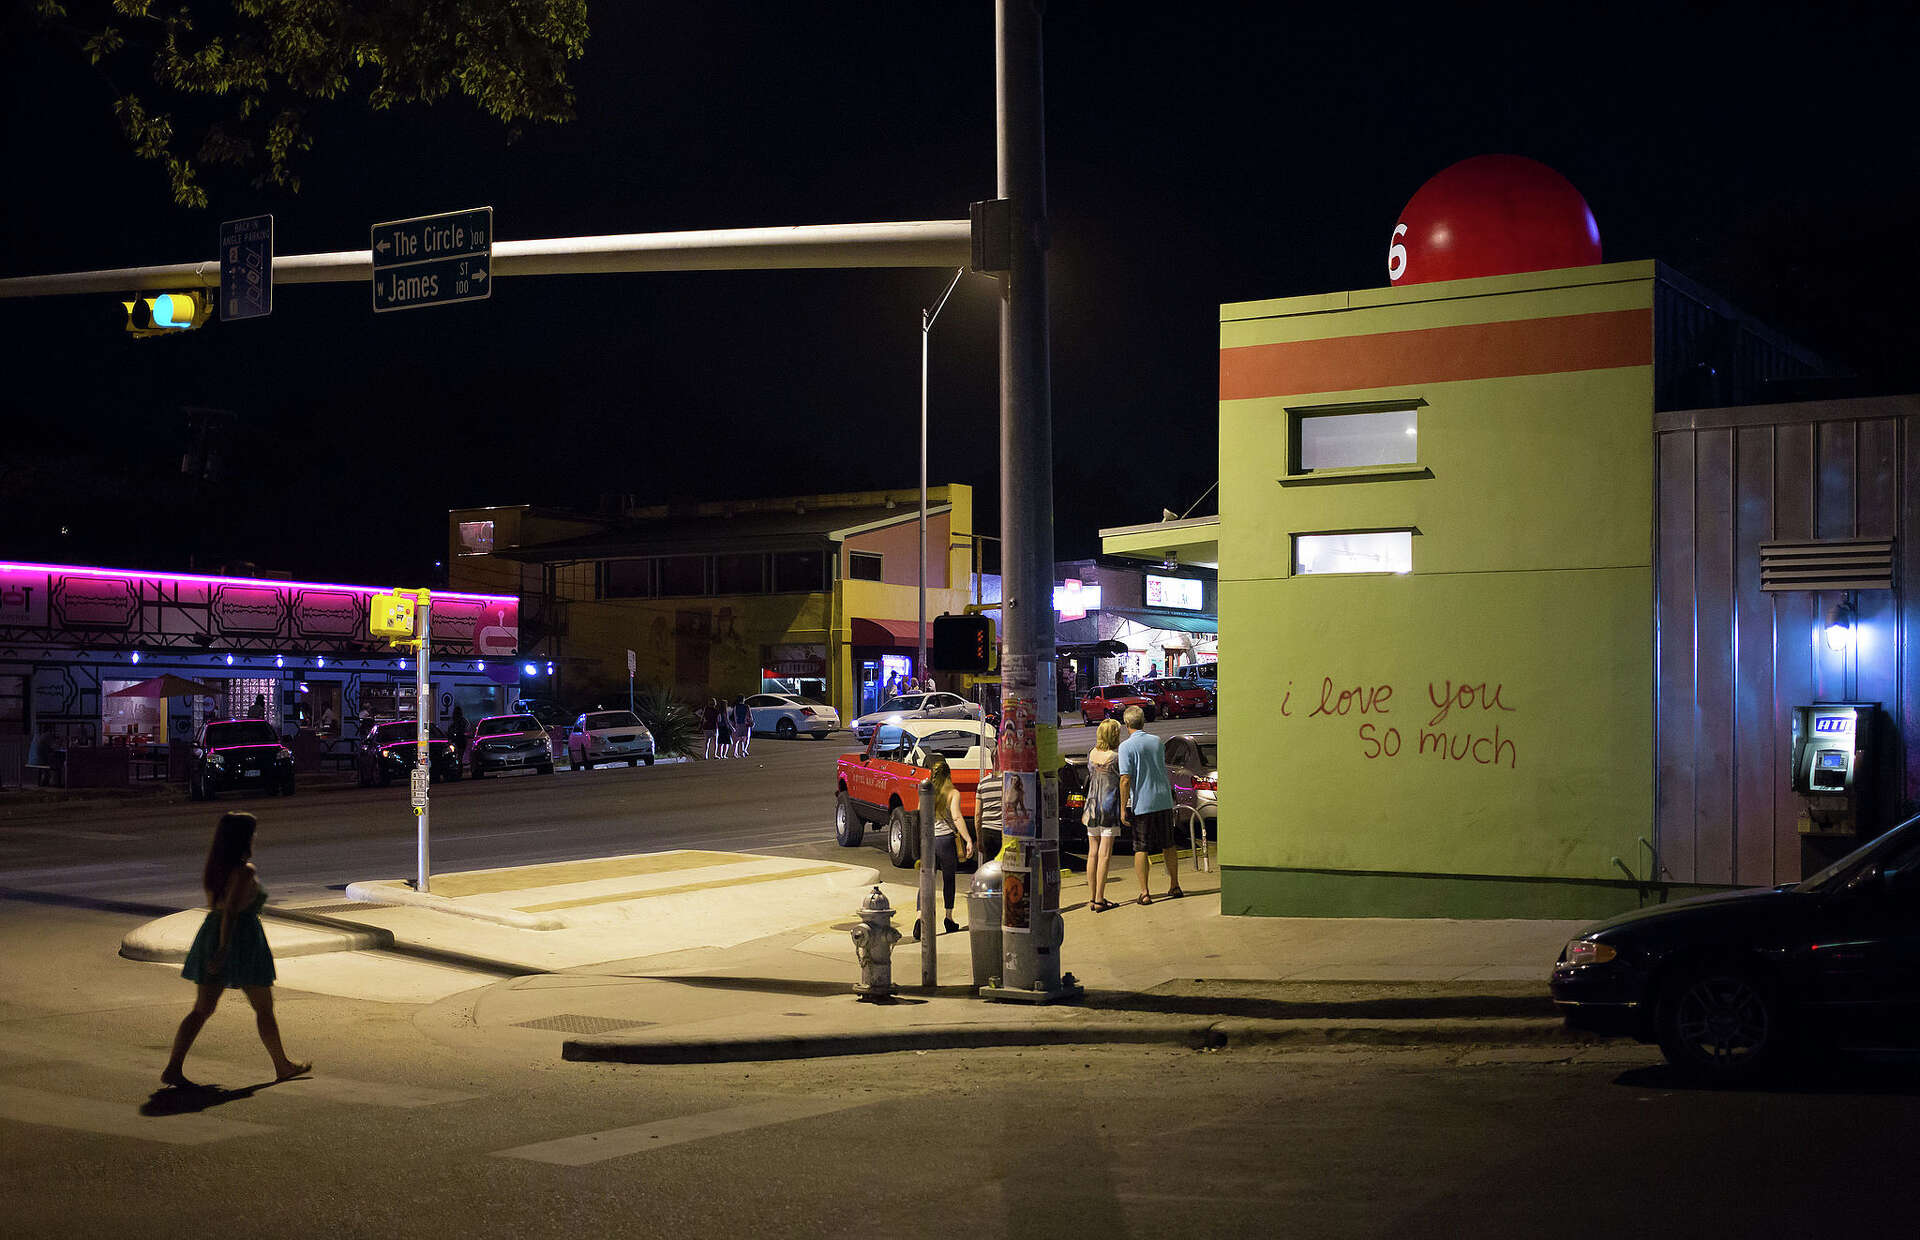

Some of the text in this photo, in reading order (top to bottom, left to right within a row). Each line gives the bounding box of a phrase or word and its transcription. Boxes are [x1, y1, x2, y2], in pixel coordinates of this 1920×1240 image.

[393, 231, 417, 257] The
[424, 223, 464, 253] Circle
[1388, 223, 1408, 280] 6
[459, 261, 469, 278] ST
[377, 273, 439, 302] W James
[456, 280, 469, 295] 100
[1281, 676, 1516, 727] i love you
[1419, 725, 1516, 768] much
